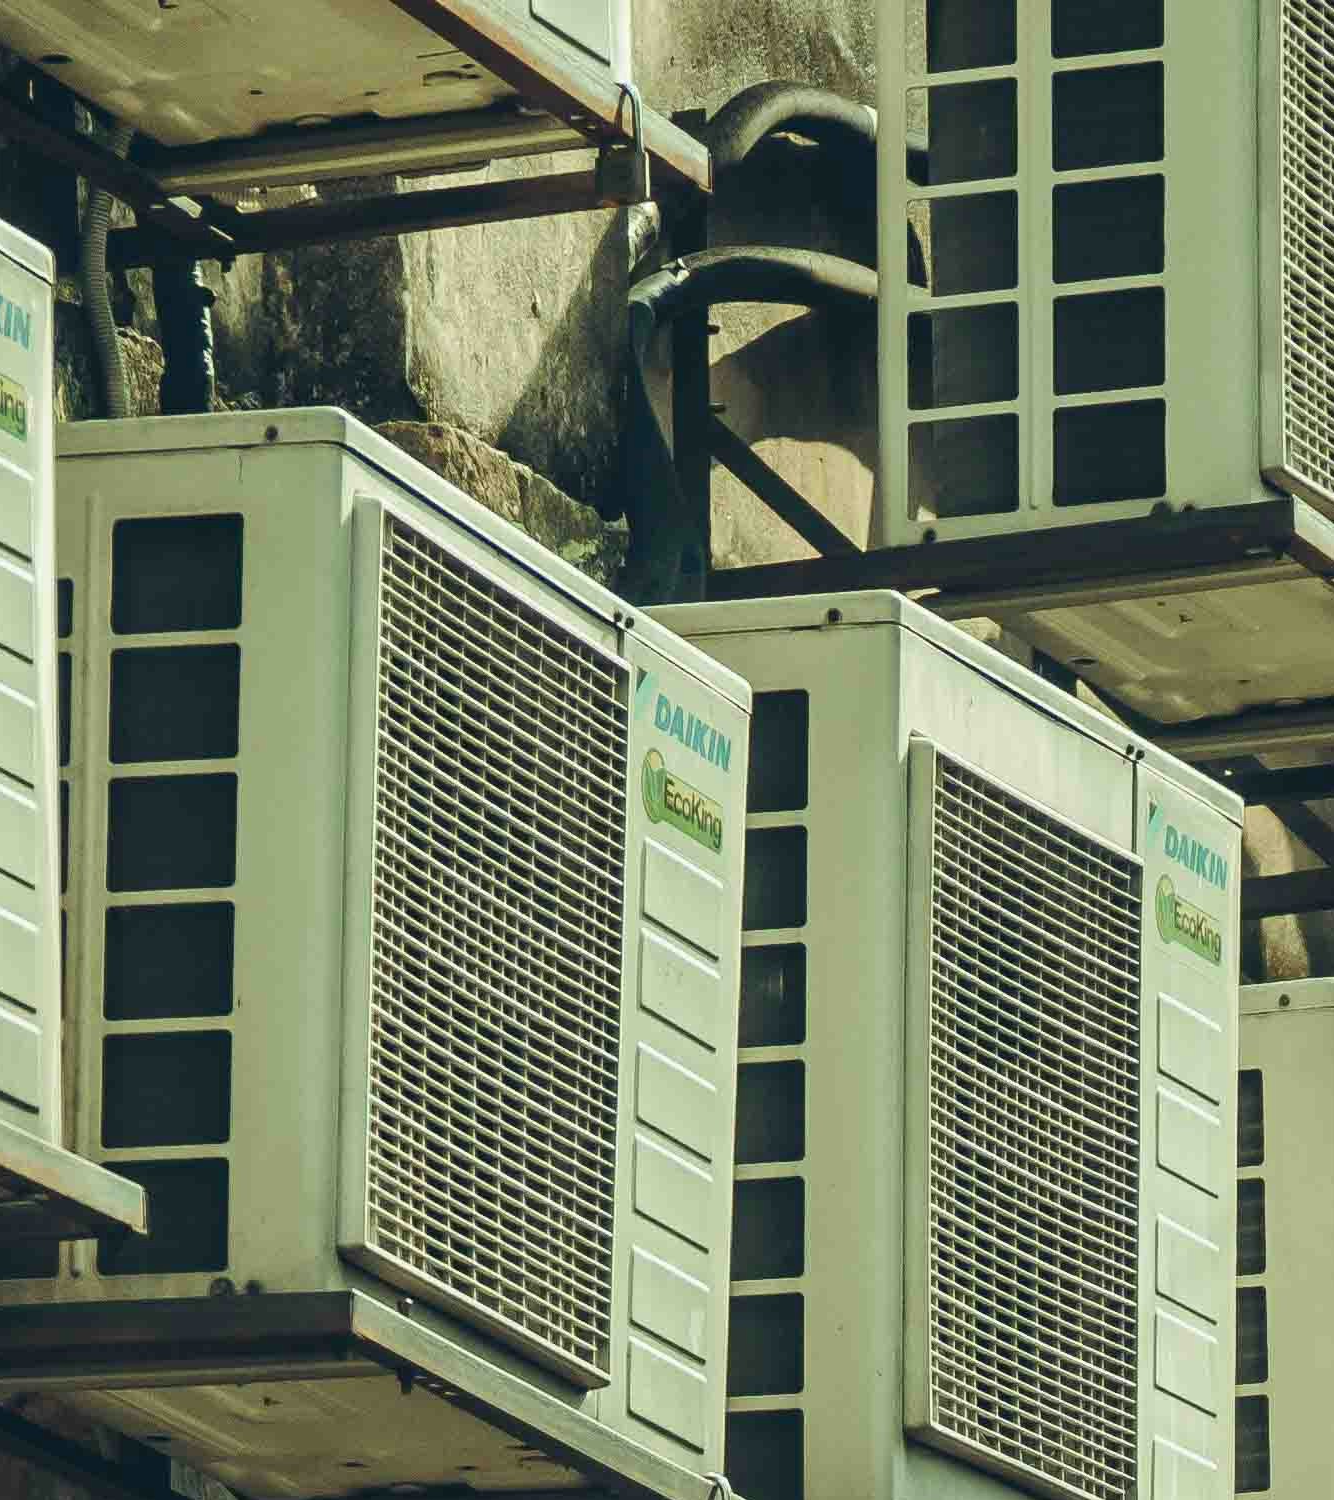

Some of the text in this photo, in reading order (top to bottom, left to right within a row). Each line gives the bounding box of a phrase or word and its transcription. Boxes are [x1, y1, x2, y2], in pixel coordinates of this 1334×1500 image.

[654, 692, 731, 772] DAIKIN
[664, 778, 722, 848] EcoKing
[1164, 824, 1228, 891] DAIKIN
[1174, 901, 1222, 964] EcoKing
